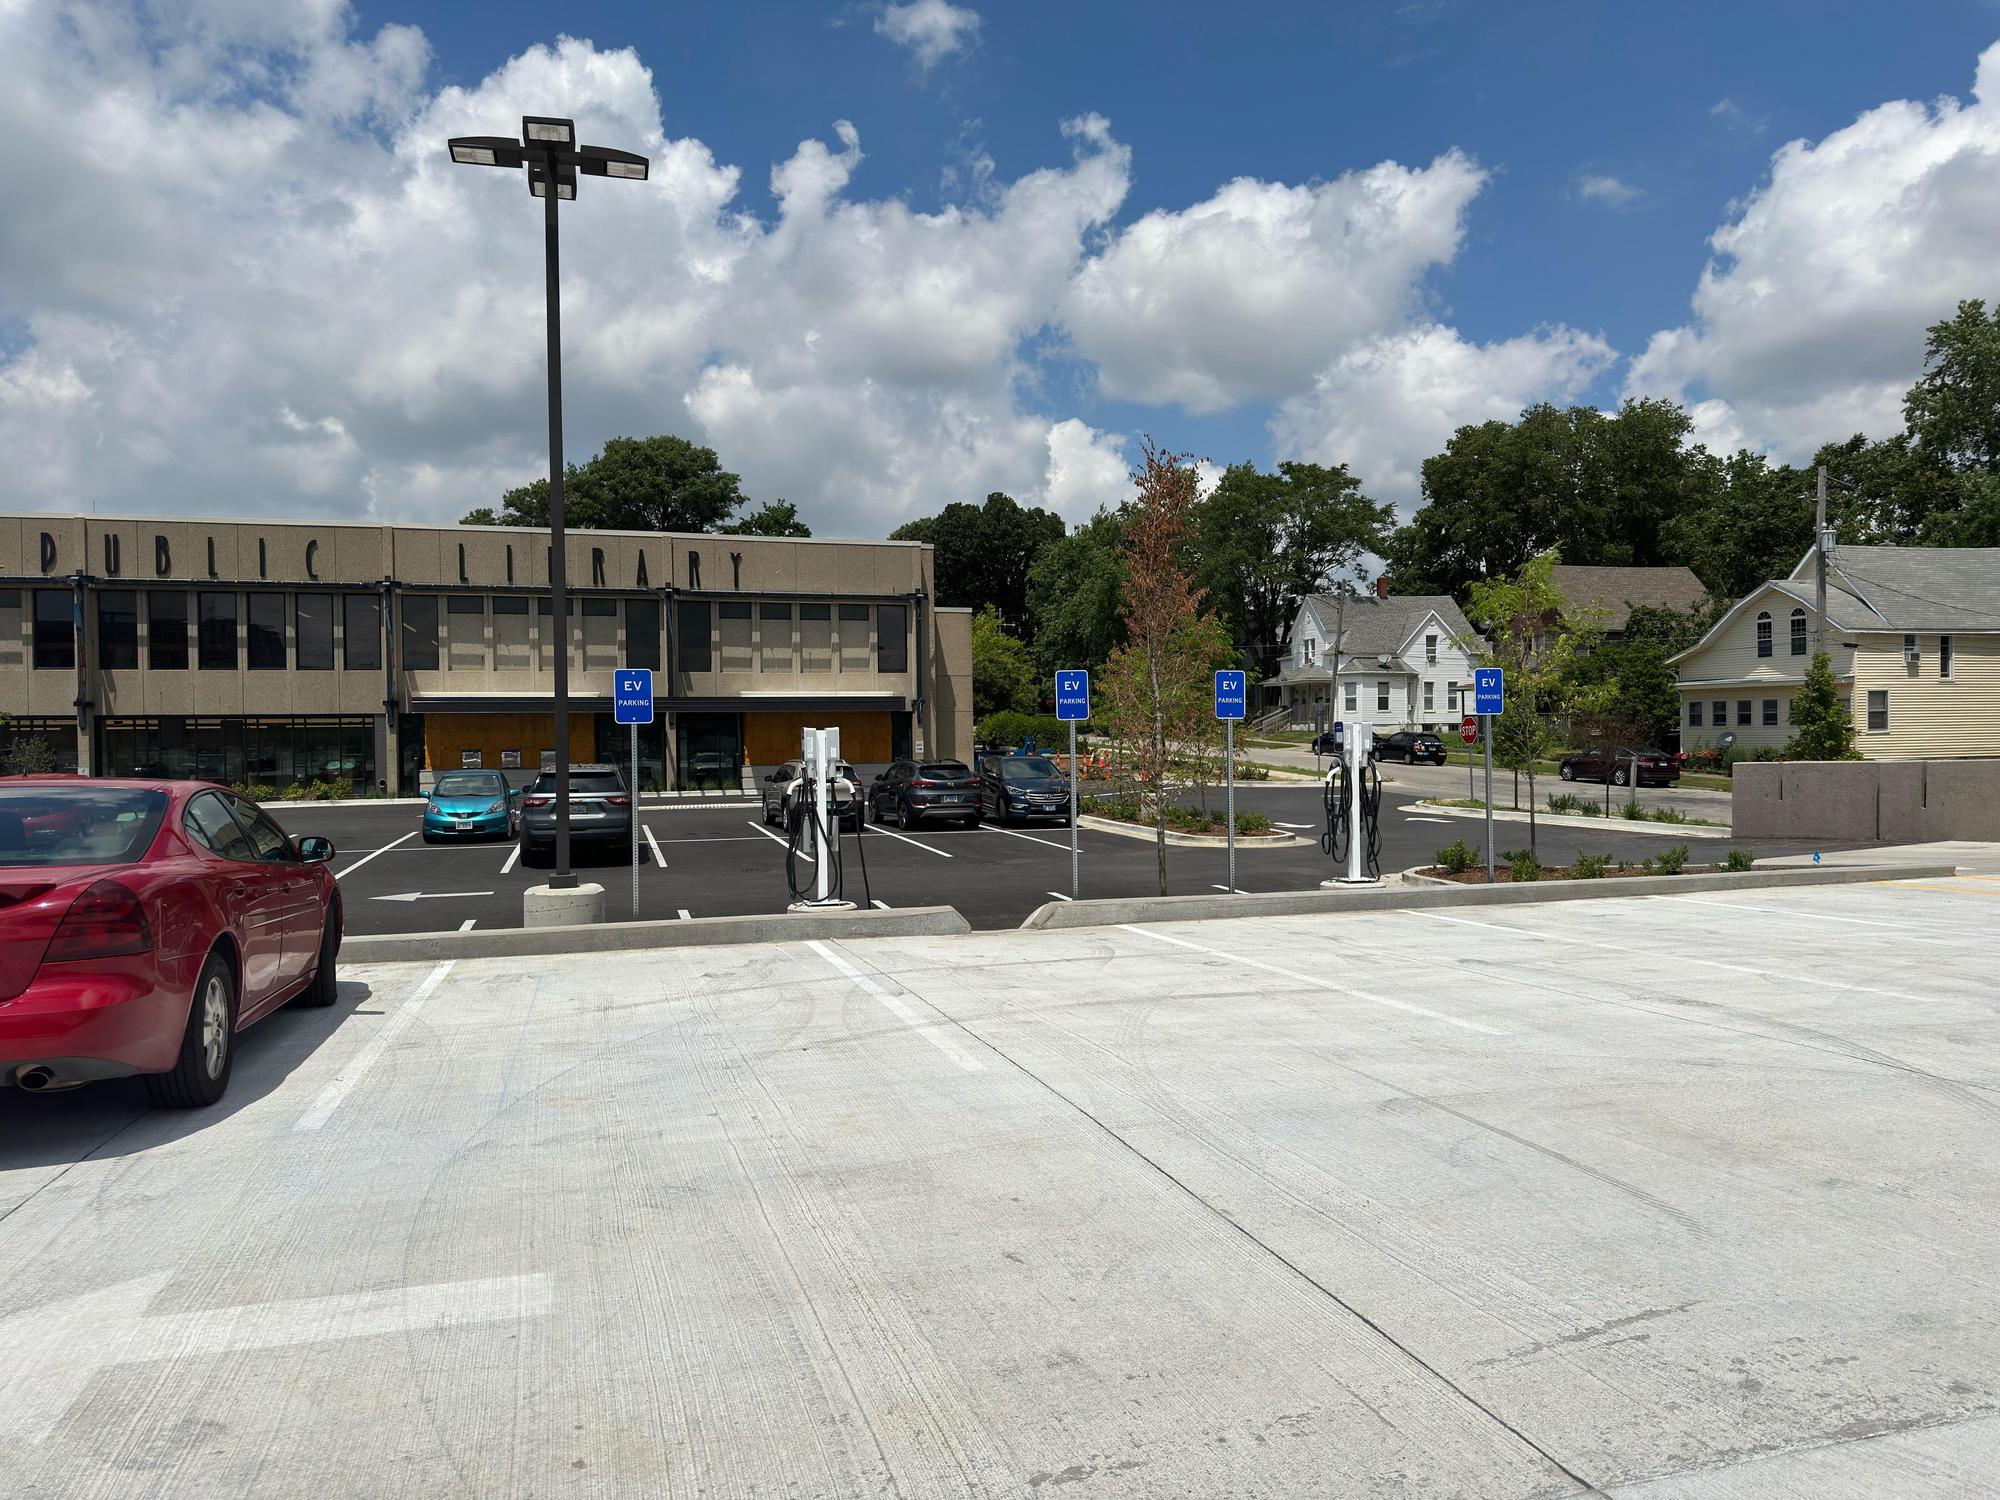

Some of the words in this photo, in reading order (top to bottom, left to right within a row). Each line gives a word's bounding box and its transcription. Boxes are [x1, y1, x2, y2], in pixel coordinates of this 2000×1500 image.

[40, 531, 319, 578] PUBLIC
[458, 542, 742, 590] LIRARY
[624, 680, 642, 691] EV
[1064, 681, 1080, 691] EV
[1222, 681, 1237, 690] EV
[1481, 678, 1496, 687] EV
[618, 699, 649, 707] PARKING
[1461, 725, 1476, 737] STOP
